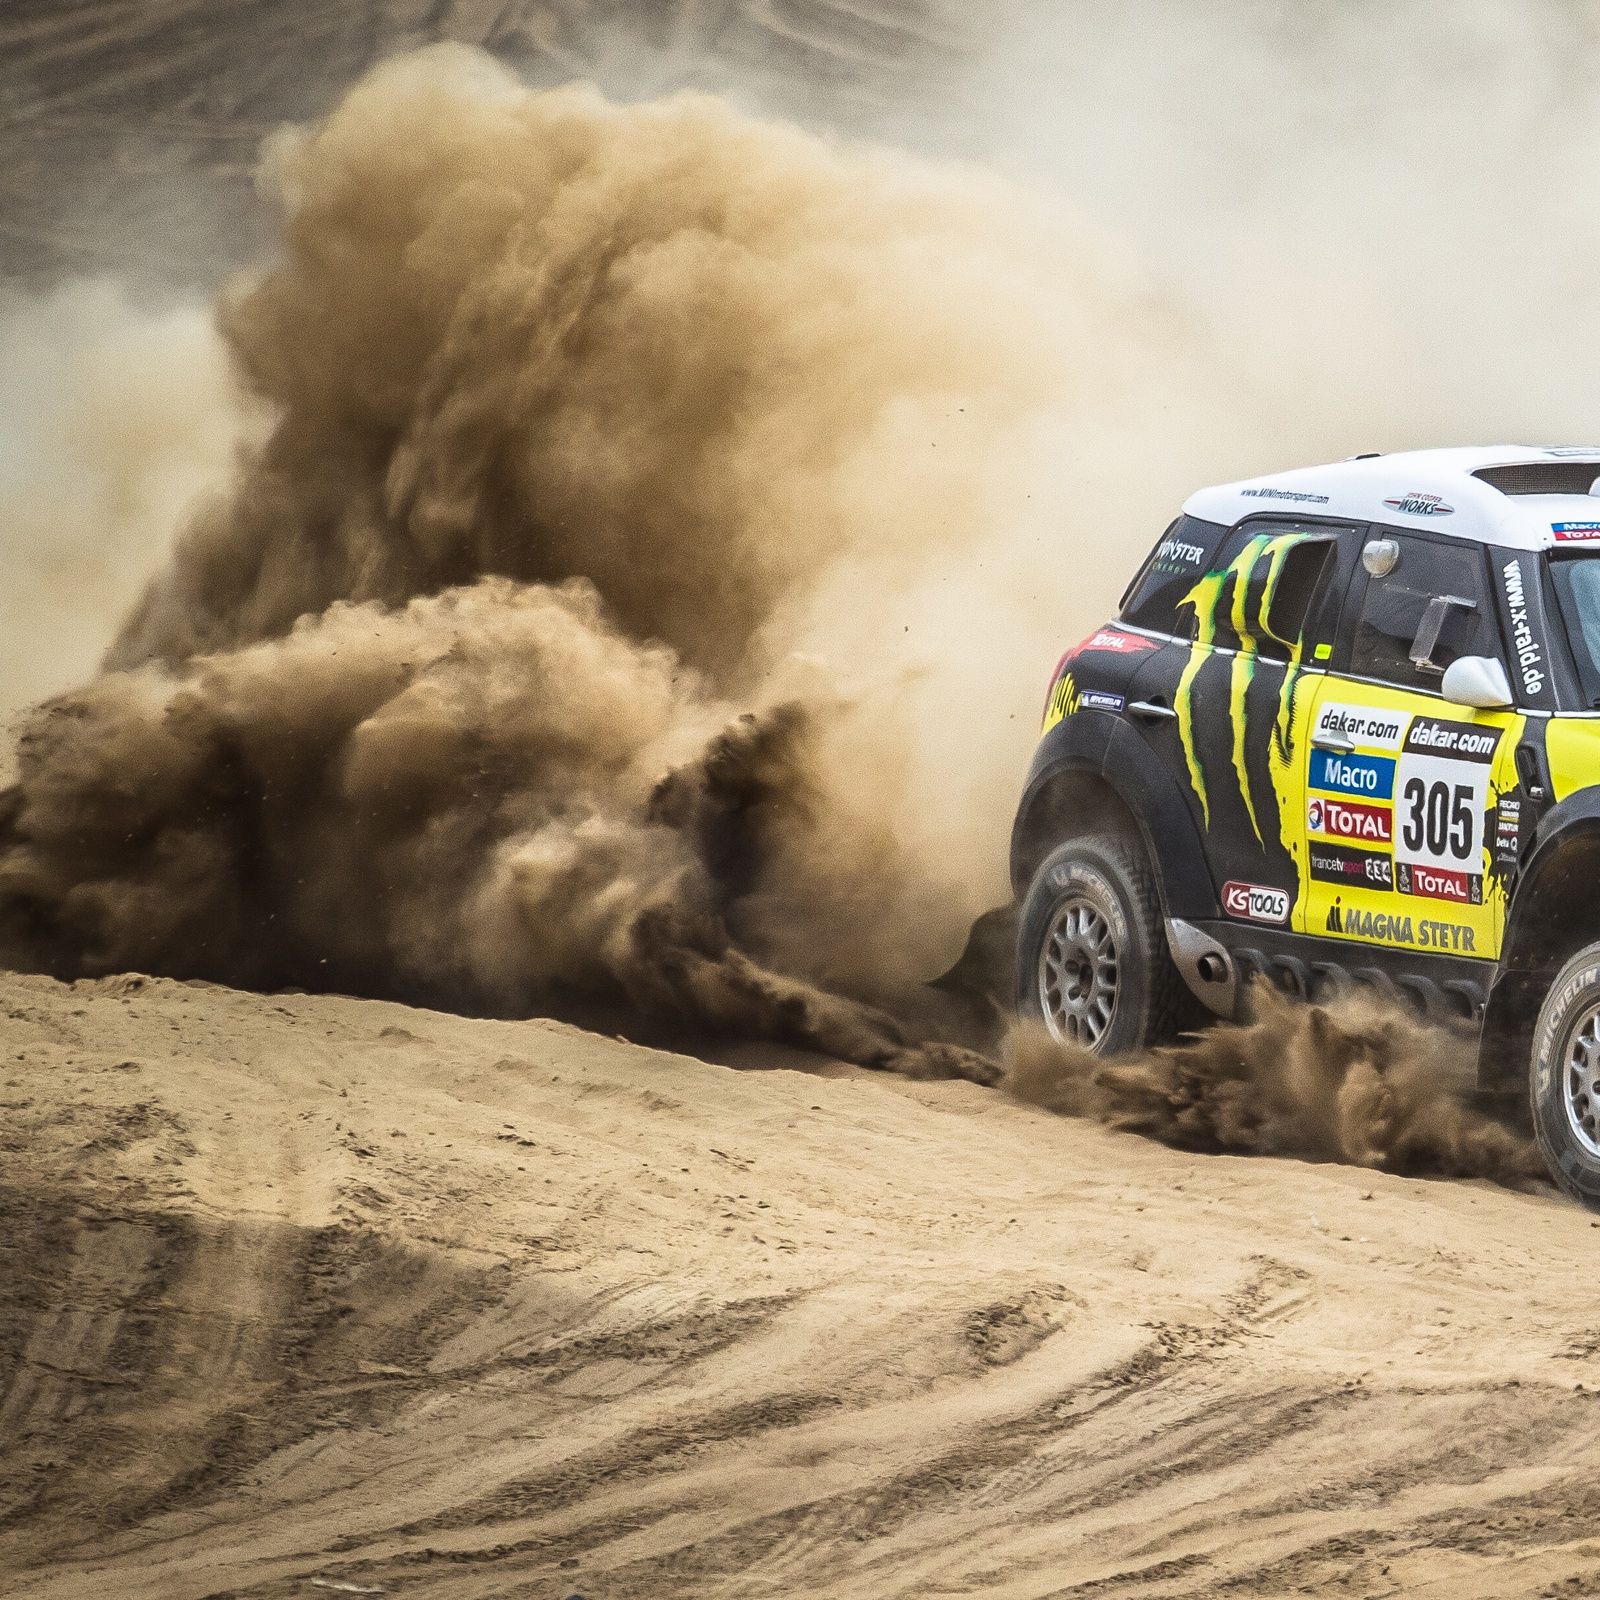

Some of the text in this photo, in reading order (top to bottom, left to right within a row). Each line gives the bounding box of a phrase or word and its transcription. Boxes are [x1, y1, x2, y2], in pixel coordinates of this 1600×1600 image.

[1398, 498, 1438, 515] WORKS
[1089, 633, 1126, 648] TOTAL
[1503, 559, 1546, 695] www.x-raid.de
[1320, 709, 1399, 740] dakar.com
[1409, 721, 1496, 755] dakar.com
[1324, 758, 1377, 790] Macro
[1326, 804, 1390, 838] TOTAL
[1402, 777, 1474, 860] 305
[1414, 870, 1467, 897] TOTAL
[1250, 892, 1286, 916] TOOLS
[1344, 907, 1477, 952] MAGNA STEYR
